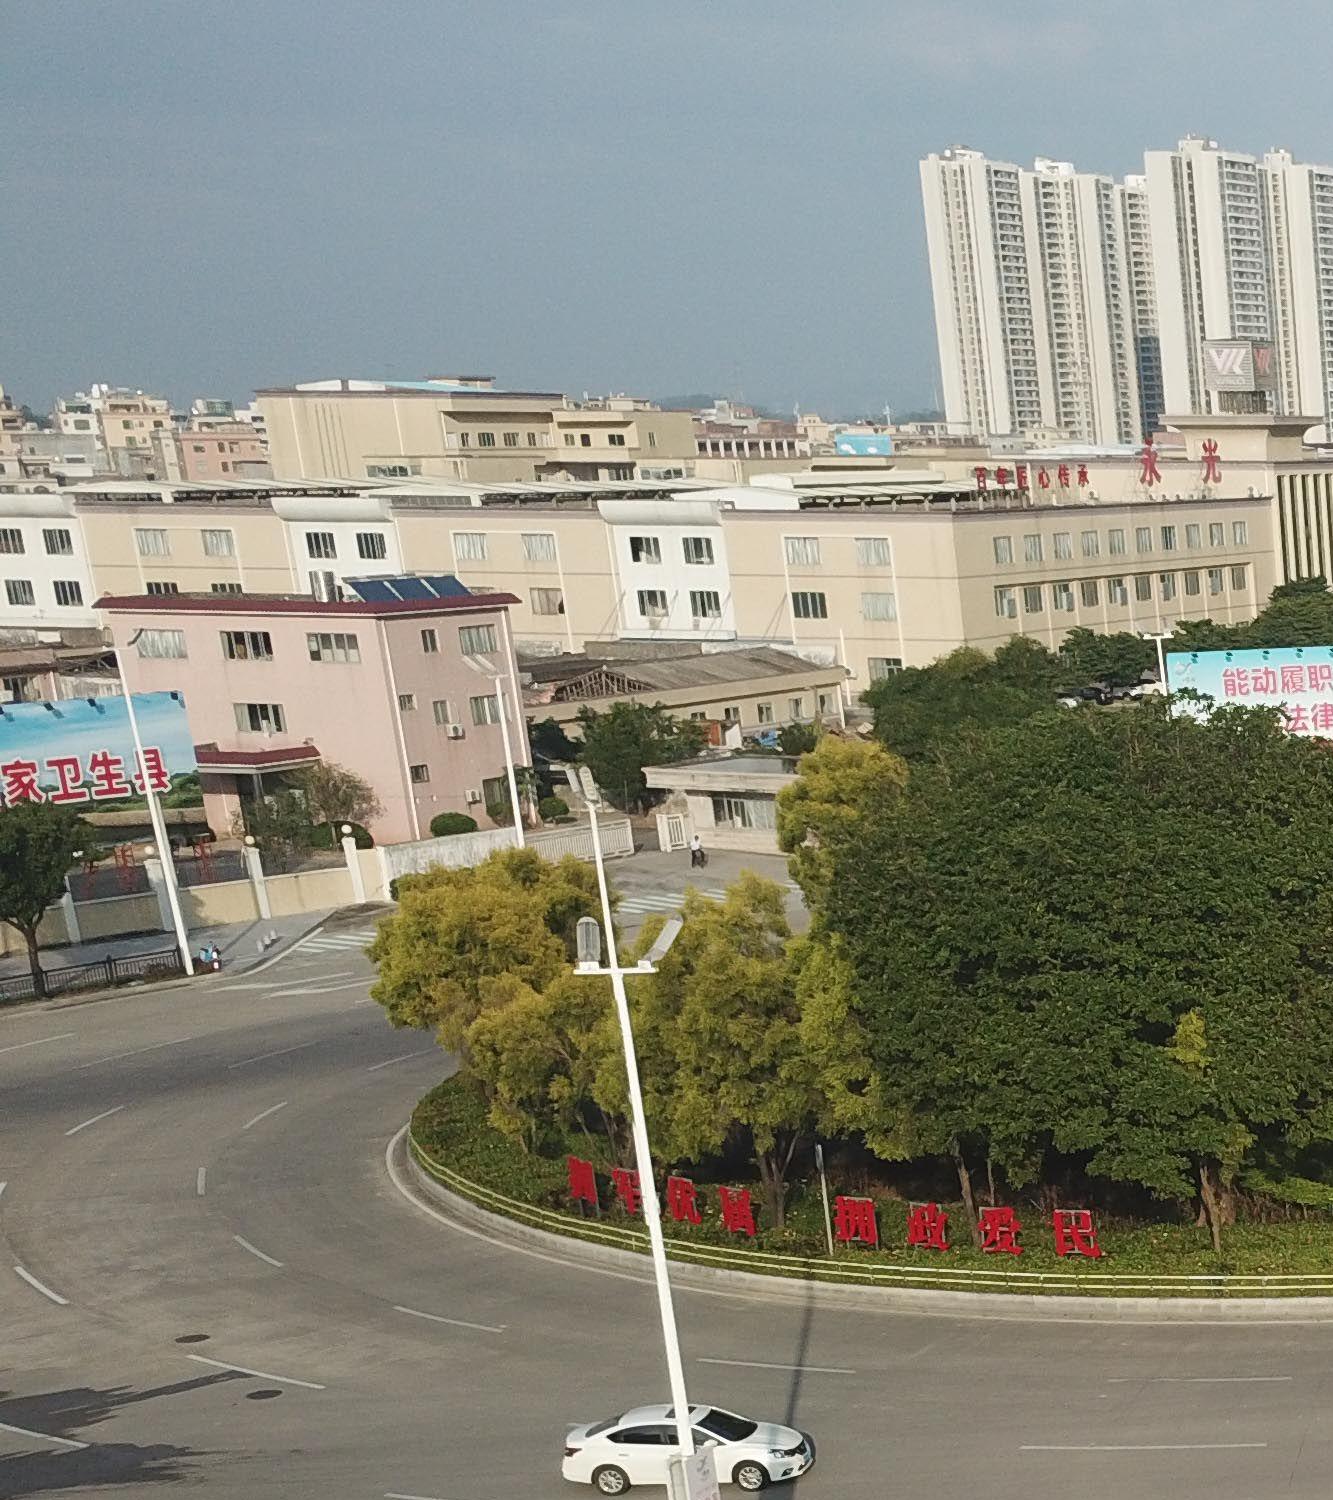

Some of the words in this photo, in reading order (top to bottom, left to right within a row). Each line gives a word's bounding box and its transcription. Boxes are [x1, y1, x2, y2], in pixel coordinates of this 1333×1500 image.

[0, 747, 171, 806] 家卫生县
[834, 1195, 1103, 1258] 拥政爱民
